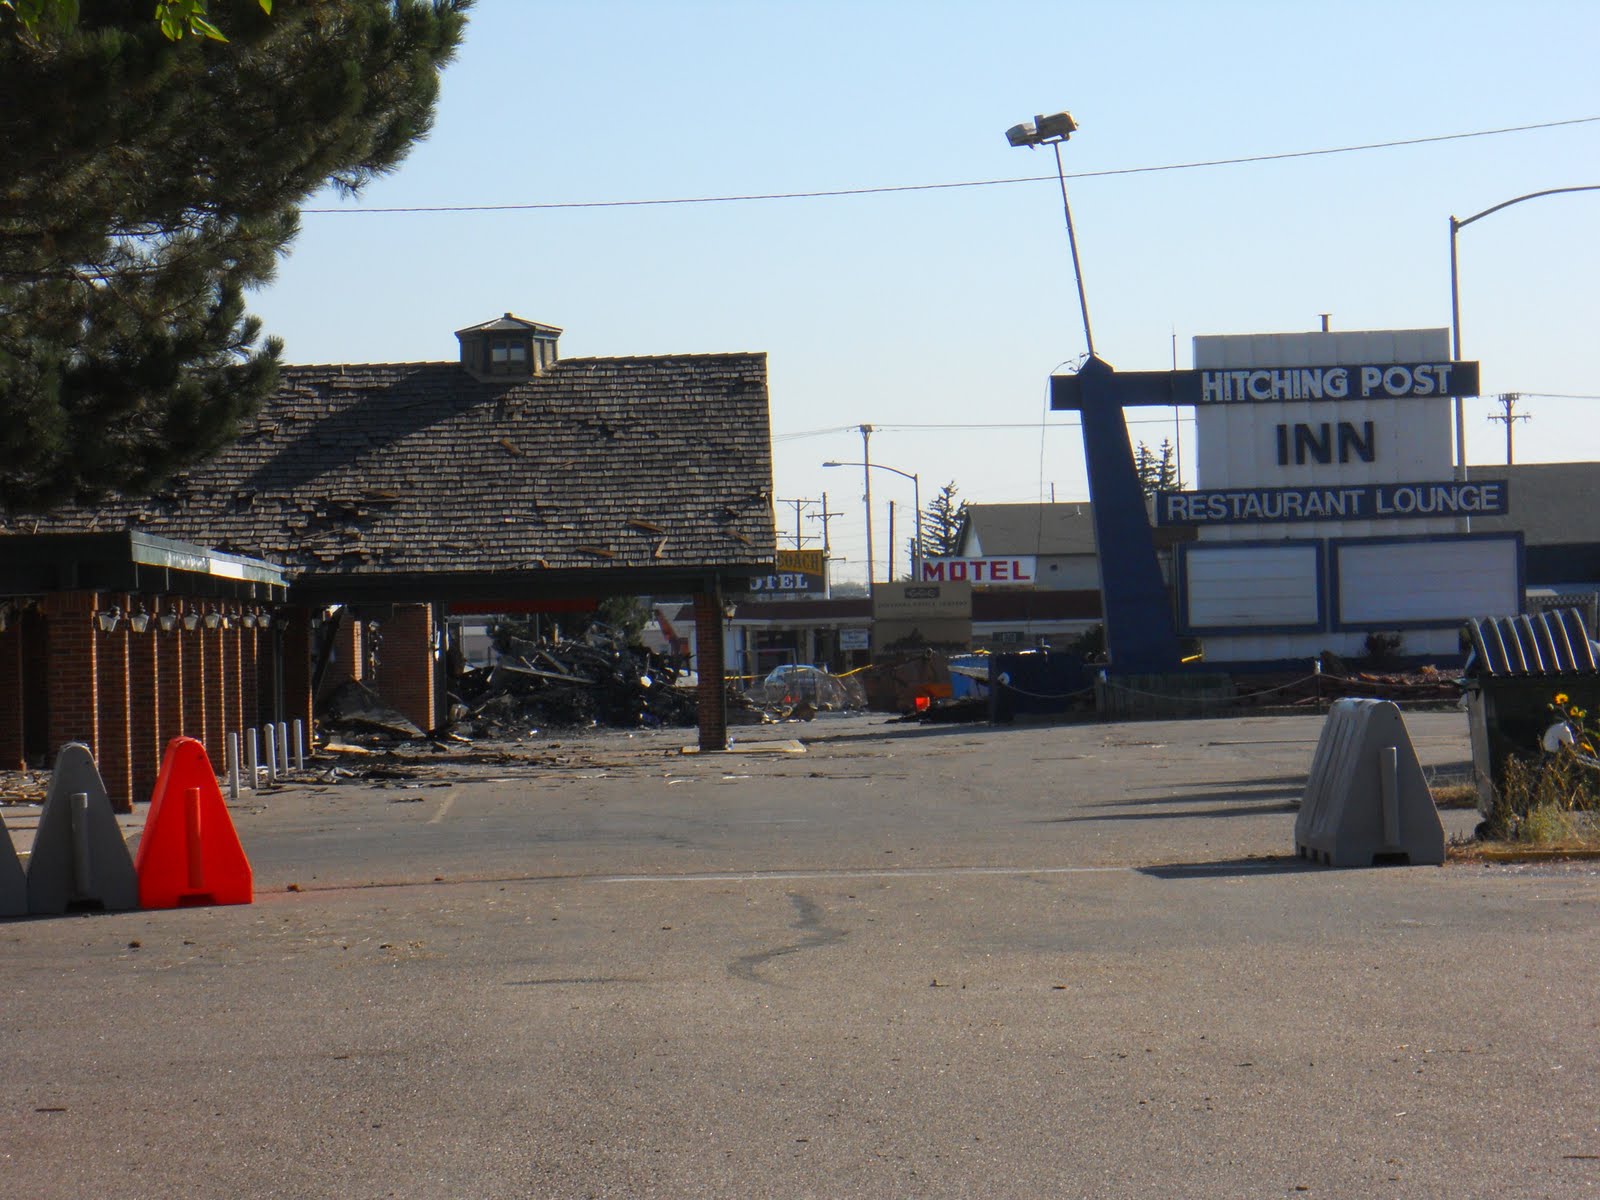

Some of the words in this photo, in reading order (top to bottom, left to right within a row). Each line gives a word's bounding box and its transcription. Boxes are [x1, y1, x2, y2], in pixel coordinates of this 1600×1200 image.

[1202, 367, 1349, 401] HITCHING
[1361, 364, 1453, 397] POST
[1276, 420, 1376, 466] INN
[1167, 489, 1365, 521] RESTAURANT
[1376, 485, 1499, 514] LOUNGE
[922, 560, 1031, 582] MOTEL
